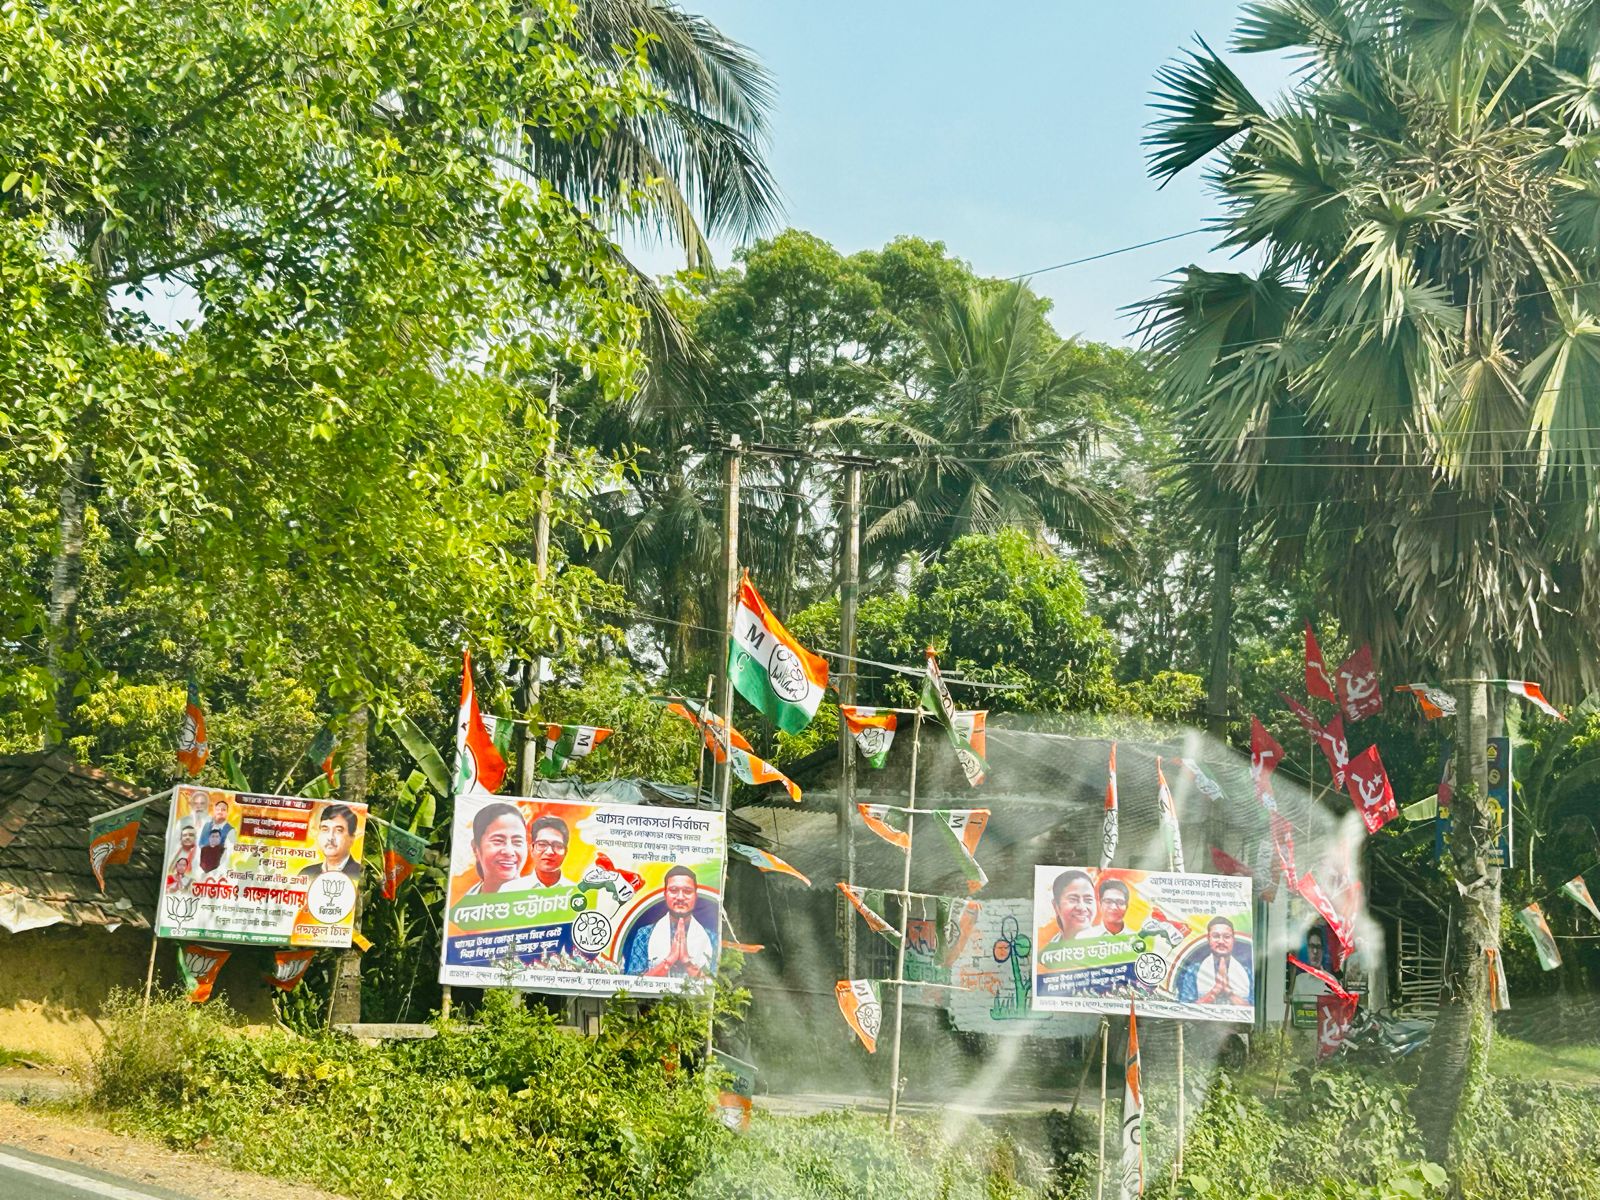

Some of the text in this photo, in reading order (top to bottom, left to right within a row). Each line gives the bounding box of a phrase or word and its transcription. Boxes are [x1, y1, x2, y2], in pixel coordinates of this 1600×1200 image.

[744, 622, 765, 650] M
[736, 651, 750, 672] C
[596, 813, 709, 831] আসন্ন লোকসভা নির্বাচনে
[192, 877, 239, 900] অভিজিৎ
[454, 888, 585, 923] দেবাংশু ভট্টাচার্য কে
[1041, 947, 1085, 964] দেবাংশু
